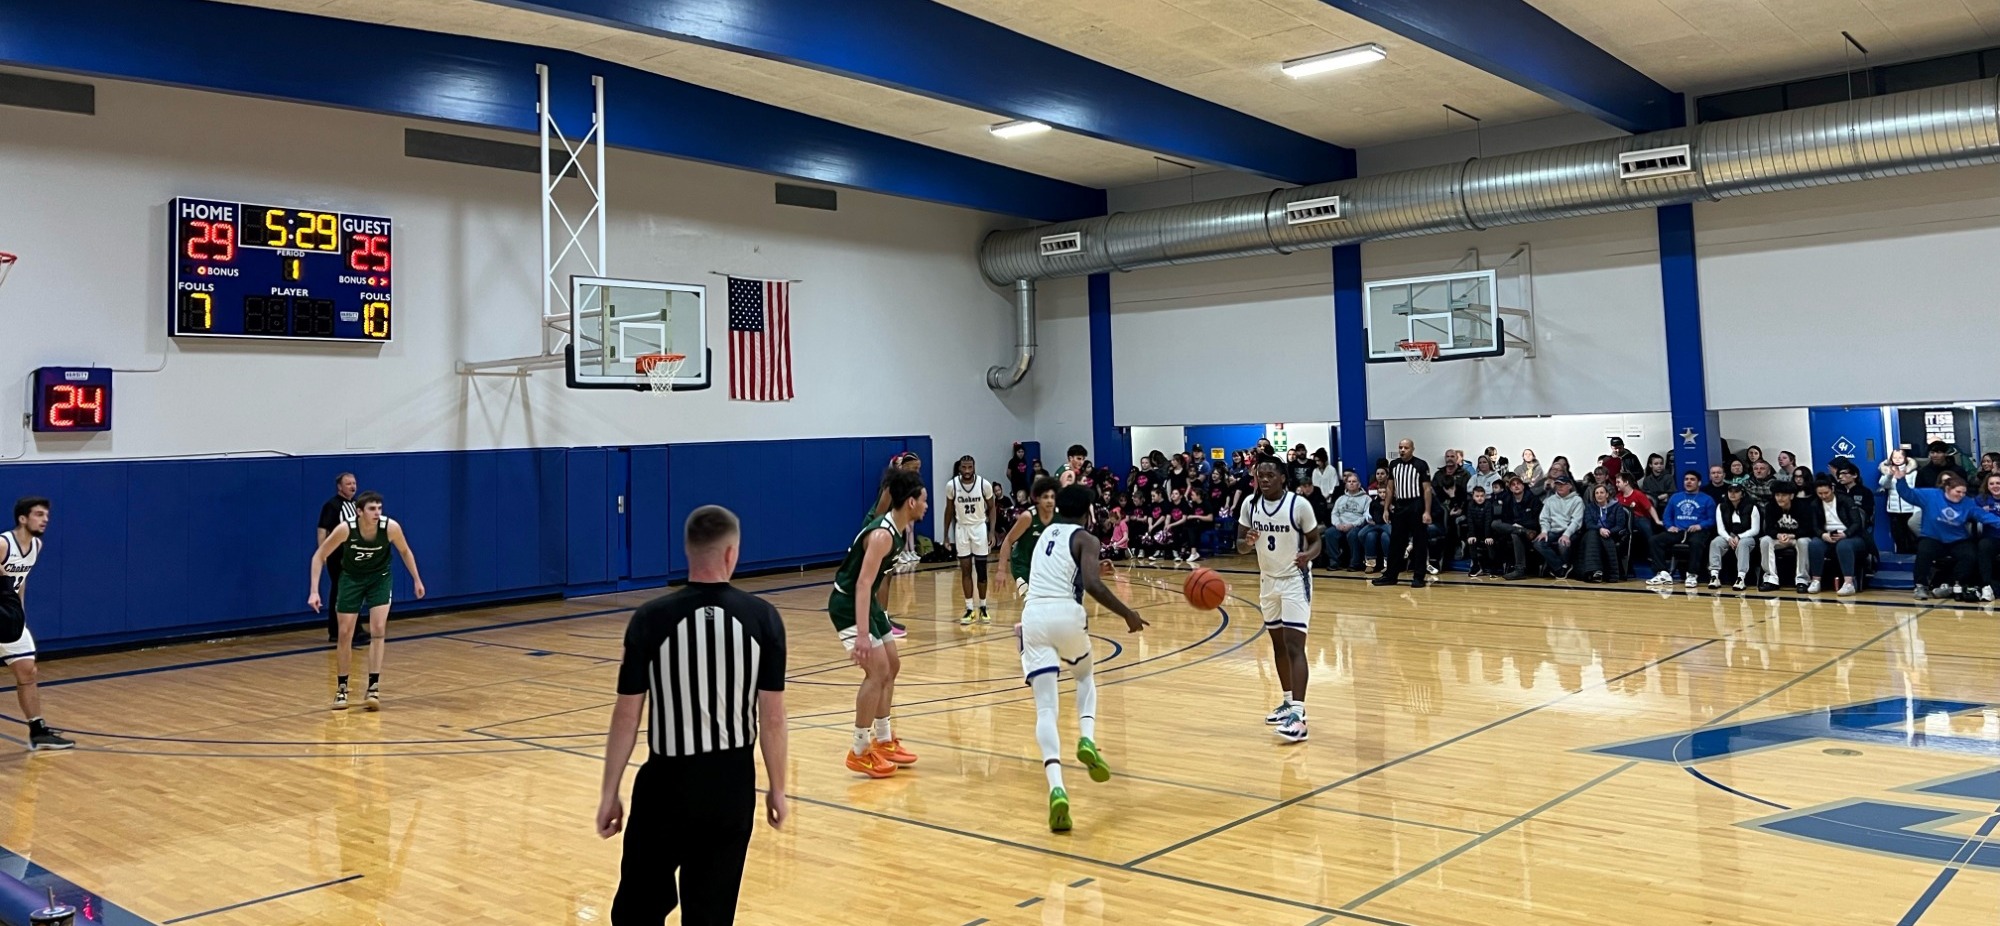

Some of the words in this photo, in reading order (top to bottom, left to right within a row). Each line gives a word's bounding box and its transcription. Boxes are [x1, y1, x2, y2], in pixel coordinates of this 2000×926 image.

[182, 202, 233, 222] HOME
[265, 209, 338, 250] 5:29
[342, 218, 391, 236] GUEST
[187, 221, 233, 261] 29
[276, 249, 306, 257] PERIOD
[350, 234, 390, 272] 25
[207, 266, 239, 277] BONUS
[292, 259, 299, 280] 1
[178, 281, 215, 292] FOULS
[338, 275, 367, 285] BONUS
[270, 287, 309, 297] PLAYER
[360, 292, 391, 301] FOULS
[190, 292, 212, 329] 7
[363, 302, 389, 338] 10
[49, 385, 102, 426] 24
[964, 504, 976, 515] 25
[1253, 520, 1290, 533] Chokers
[1045, 540, 1056, 557] 0
[1267, 534, 1276, 552] 3
[4, 563, 32, 573] Choker
